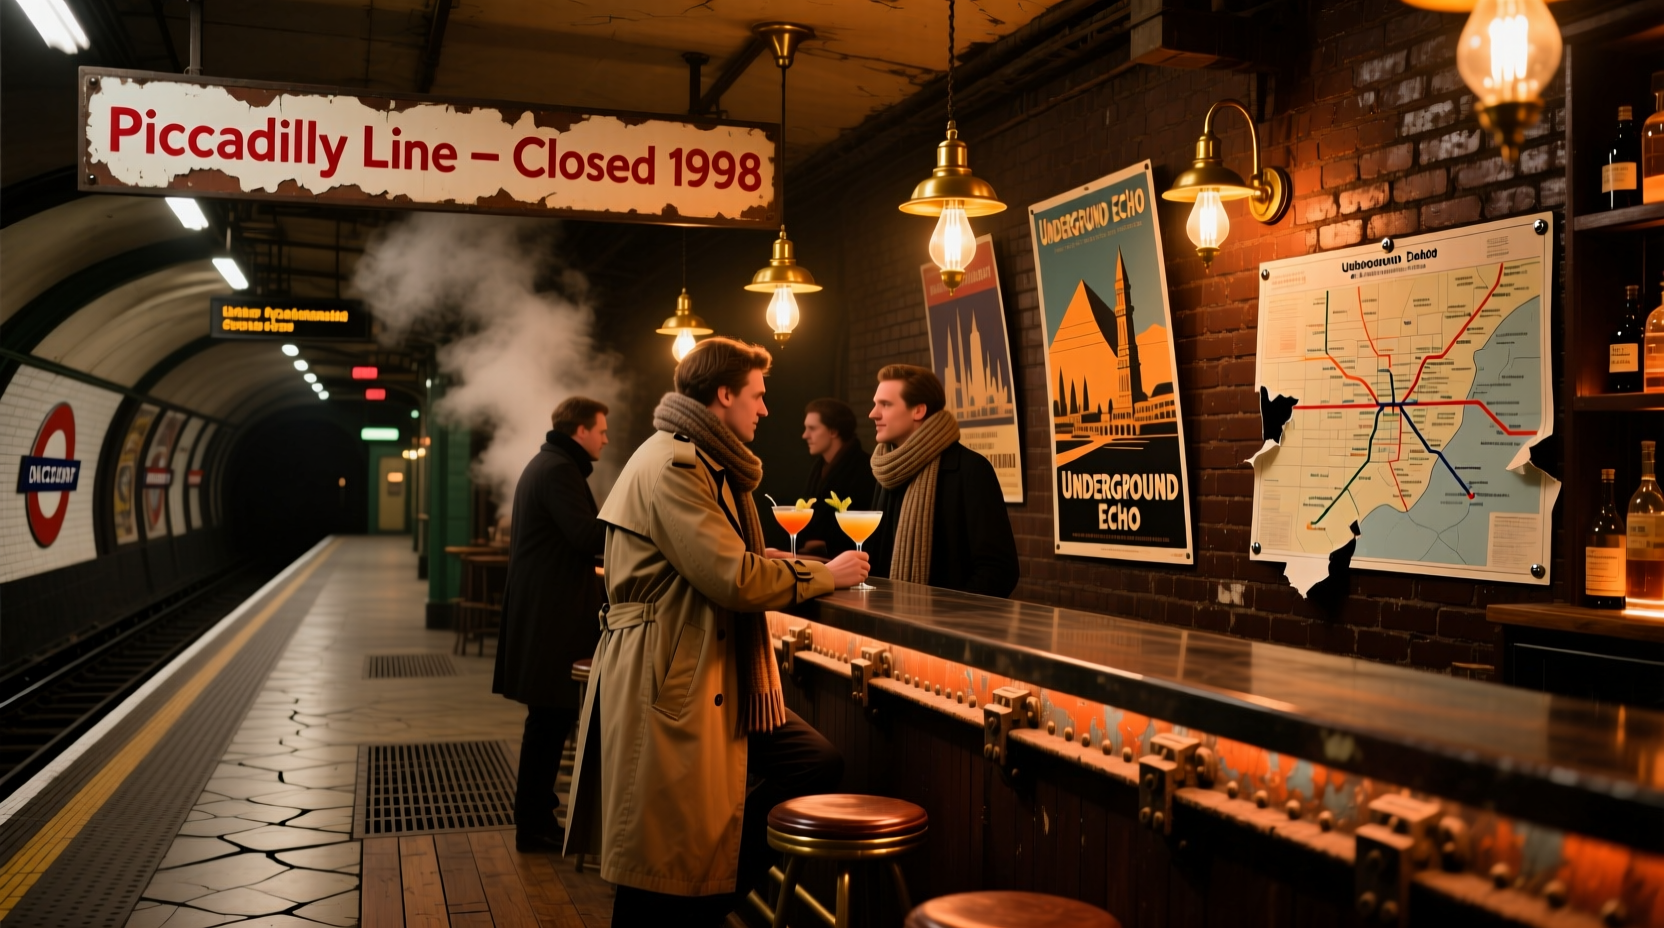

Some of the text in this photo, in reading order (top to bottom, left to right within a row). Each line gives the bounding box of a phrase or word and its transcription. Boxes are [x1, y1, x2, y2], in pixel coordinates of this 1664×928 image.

[109, 105, 348, 179] Piccadilly
[363, 125, 458, 173] Line
[513, 136, 656, 186] Closed
[669, 147, 763, 192] 1998
[1111, 188, 1145, 223] ECHO
[1098, 502, 1141, 531] ECHO
